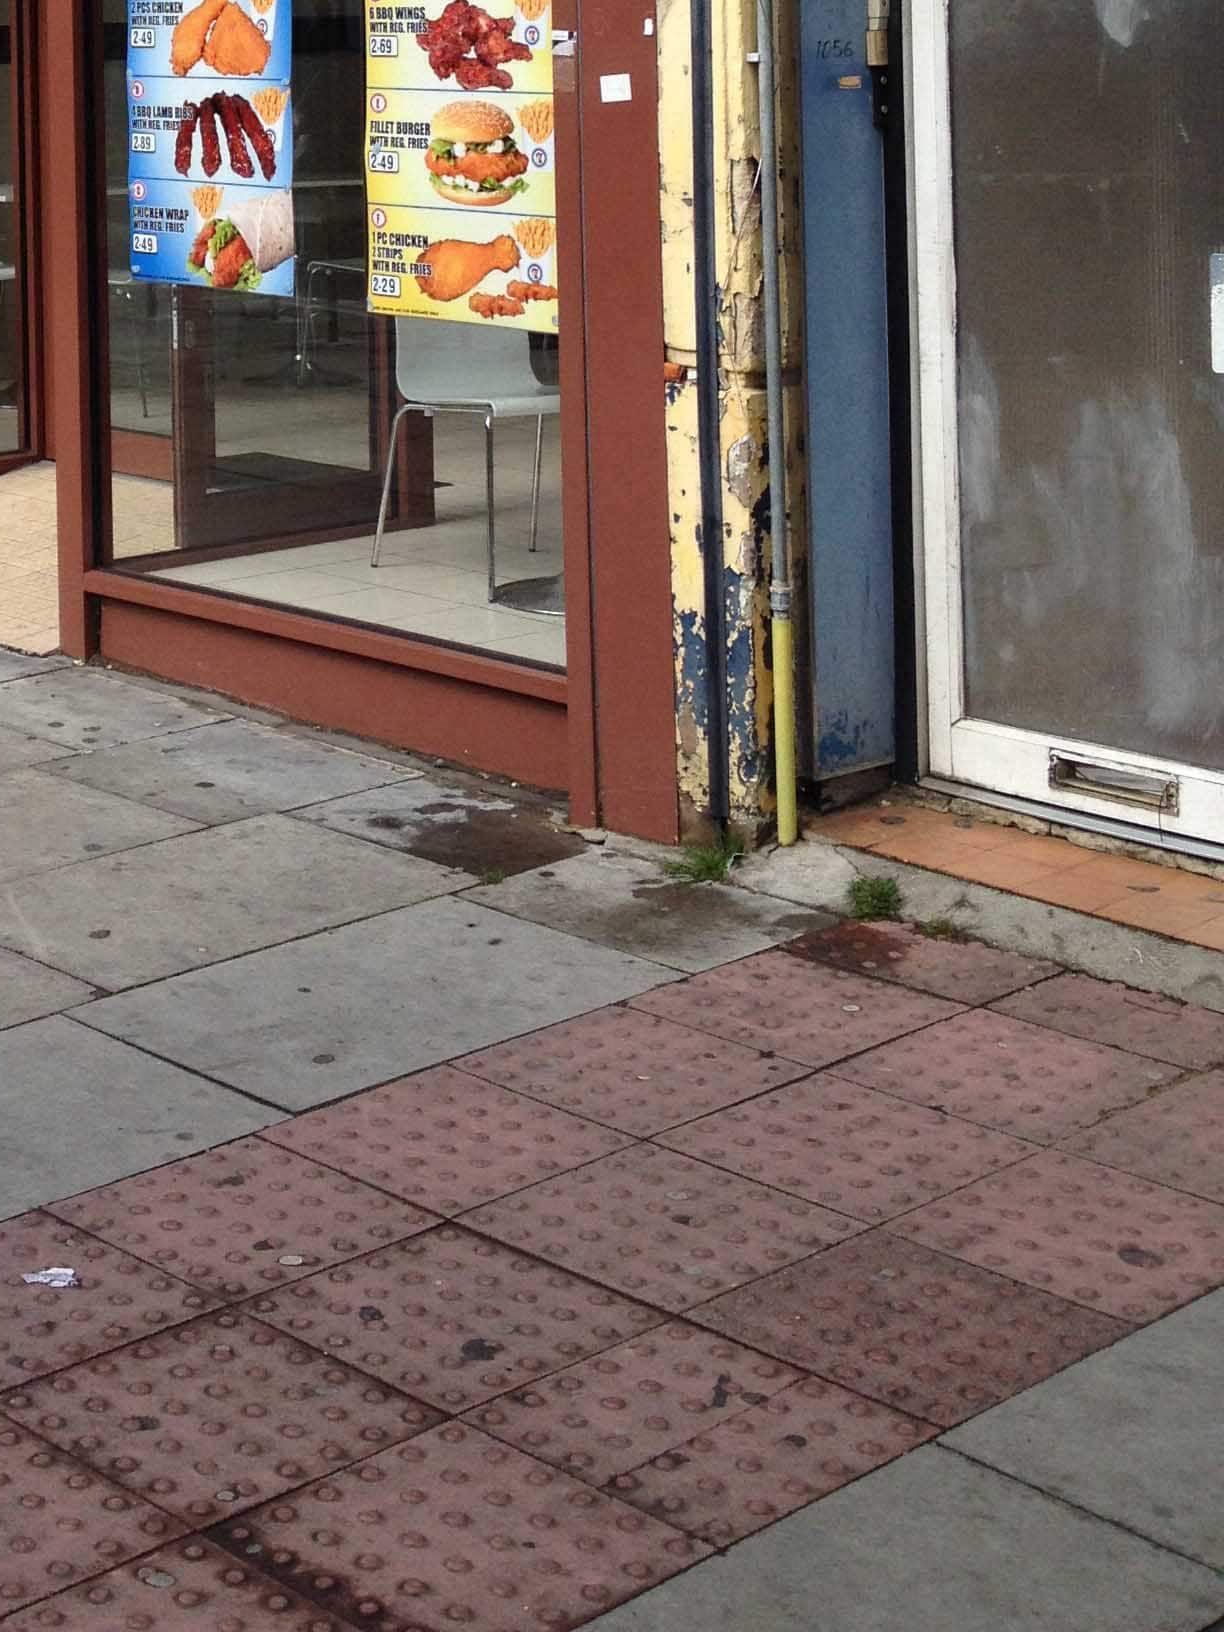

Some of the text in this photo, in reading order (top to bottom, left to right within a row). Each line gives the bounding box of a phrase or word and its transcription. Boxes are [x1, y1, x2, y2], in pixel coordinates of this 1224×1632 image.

[137, 1, 151, 14] PCS
[152, 1, 184, 14] CHICKEN
[375, 6, 393, 20] BBQ
[395, 6, 425, 21] WINGS
[131, 16, 147, 26] WITH
[162, 16, 179, 26] FRIES
[370, 21, 388, 33] WITH
[407, 22, 427, 34] FRIES
[815, 39, 855, 60] 1056
[137, 105, 152, 118] BBQ
[153, 105, 173, 118] LAMB
[175, 106, 194, 120] RIBS
[132, 119, 147, 129] WITH
[163, 119, 180, 131] FRIES
[370, 120, 431, 136] FILLET BURGER
[407, 137, 429, 150] FRIES
[133, 206, 189, 221] CHICKEN WRAP
[134, 220, 148, 230] WITH
[165, 222, 185, 233] FRIES
[377, 232, 388, 245] PC
[389, 233, 429, 249] CHICKEN
[377, 247, 404, 260] STRIPS
[373, 261, 390, 273] WITH
[409, 263, 432, 276] FRIES
